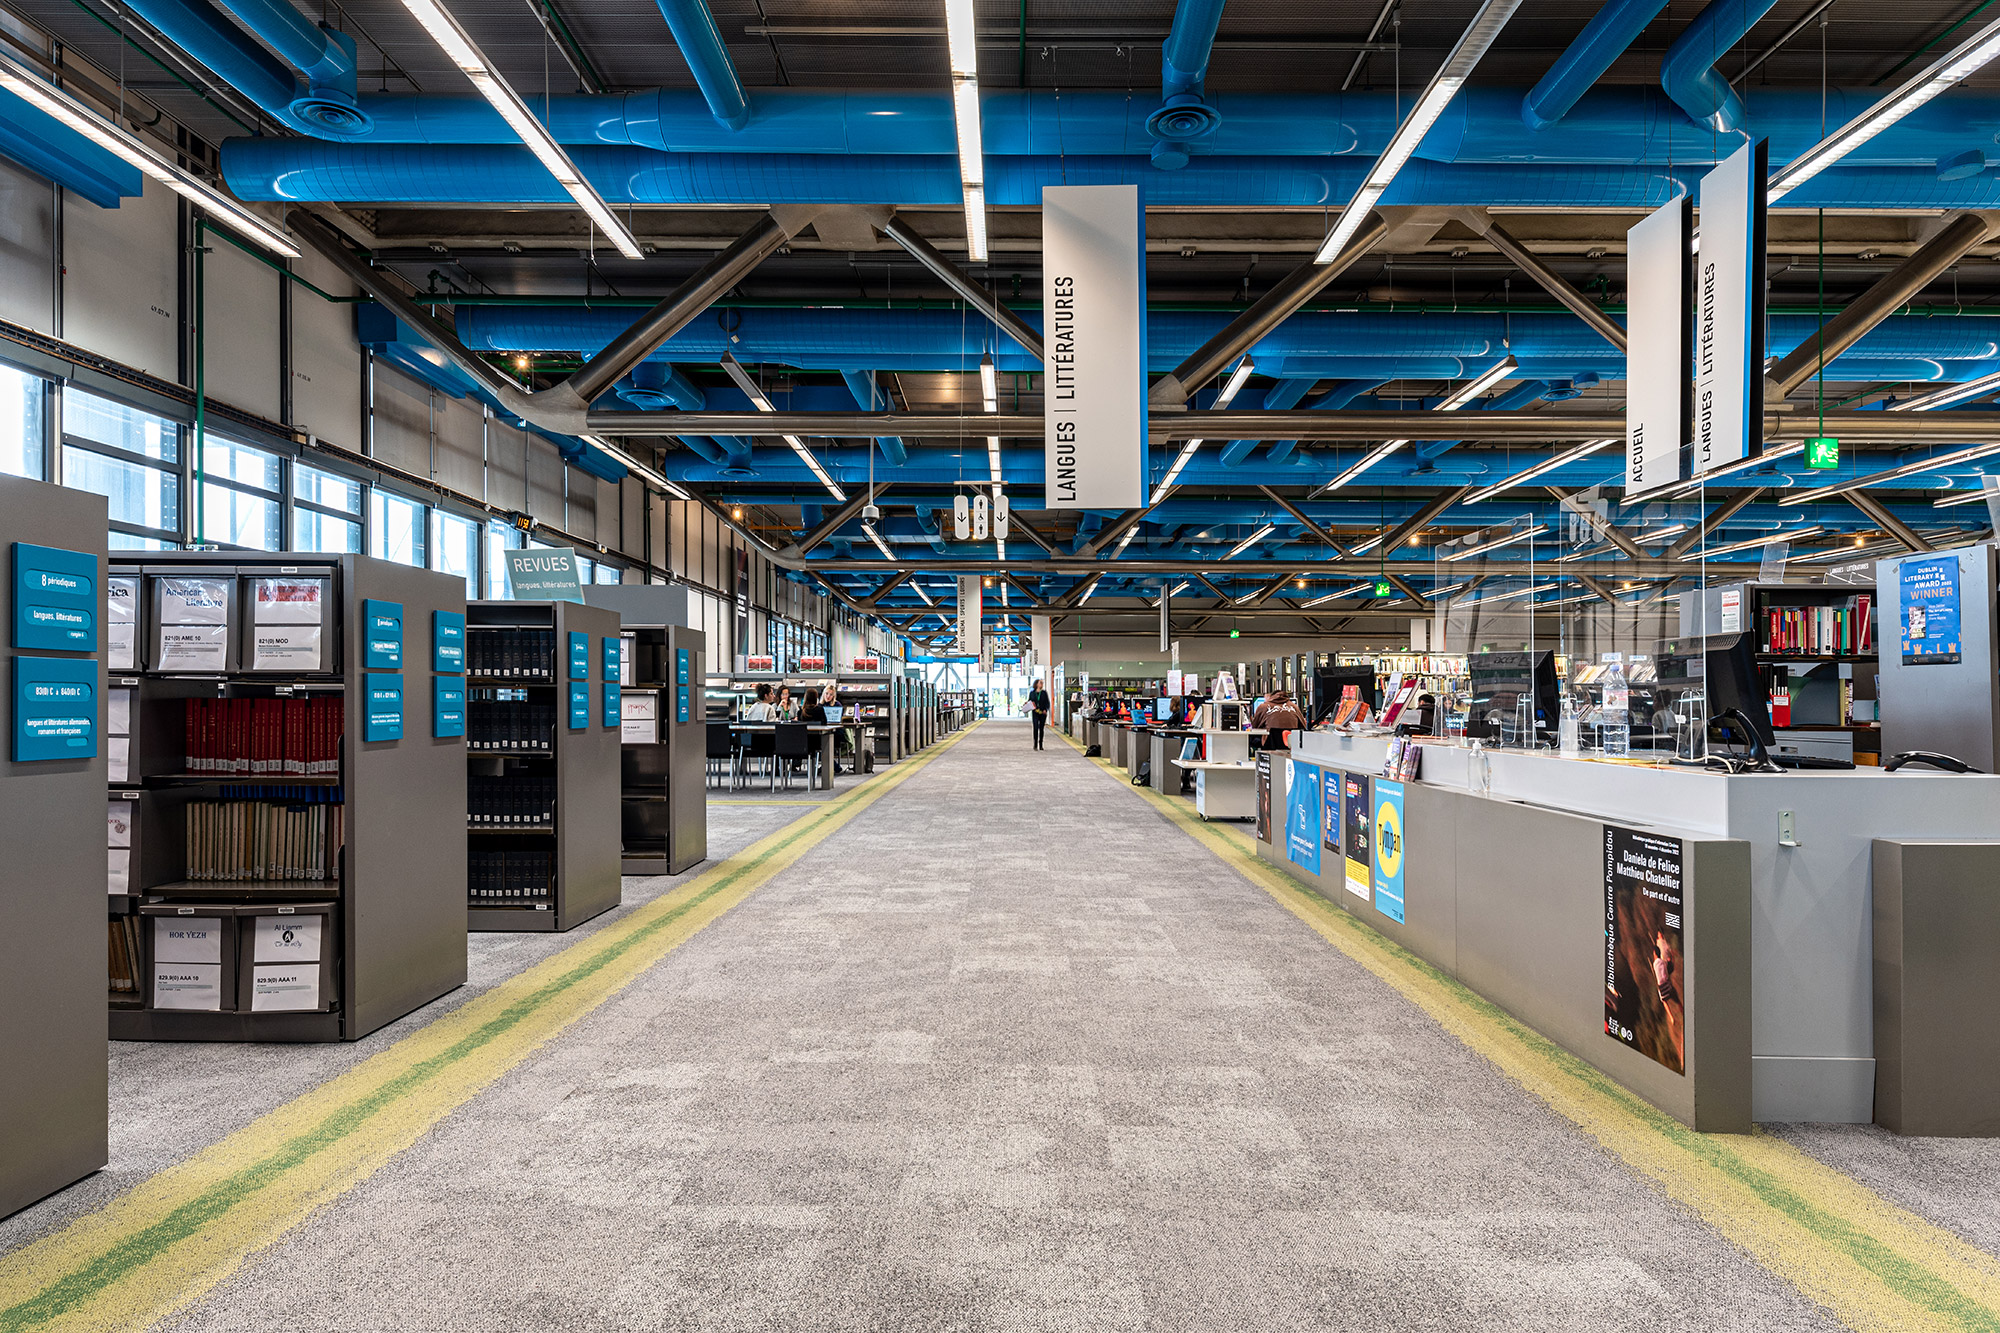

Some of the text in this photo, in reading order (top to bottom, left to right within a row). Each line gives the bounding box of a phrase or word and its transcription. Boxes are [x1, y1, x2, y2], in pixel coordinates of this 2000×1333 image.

[1702, 262, 1716, 463] LANGUES LITTÉRATURES
[1051, 276, 1076, 501] LANGUES LITTÉRATURES
[1632, 422, 1644, 483] ACCUEIL
[513, 557, 570, 572] REVUES
[1918, 566, 1938, 574] DUBLIN
[41, 574, 77, 588] 8 périodiques
[1904, 573, 1934, 582] LITERARY
[516, 581, 576, 591] langues, littératures
[1914, 580, 1940, 589] AWARD
[1910, 587, 1953, 600] WINNER
[33, 610, 82, 622] langues, littératures
[1494, 656, 1518, 664] acer
[49, 687, 54, 696] C
[76, 688, 81, 696] C
[1623, 849, 1680, 875] Daniela de Felice
[1616, 862, 1680, 890] Matthieu Chatellier
[1642, 887, 1680, 905] De part et d'autre
[1605, 830, 1615, 990] Bibliothèque Centre Pompidou
[169, 931, 207, 939] HOR YEZH
